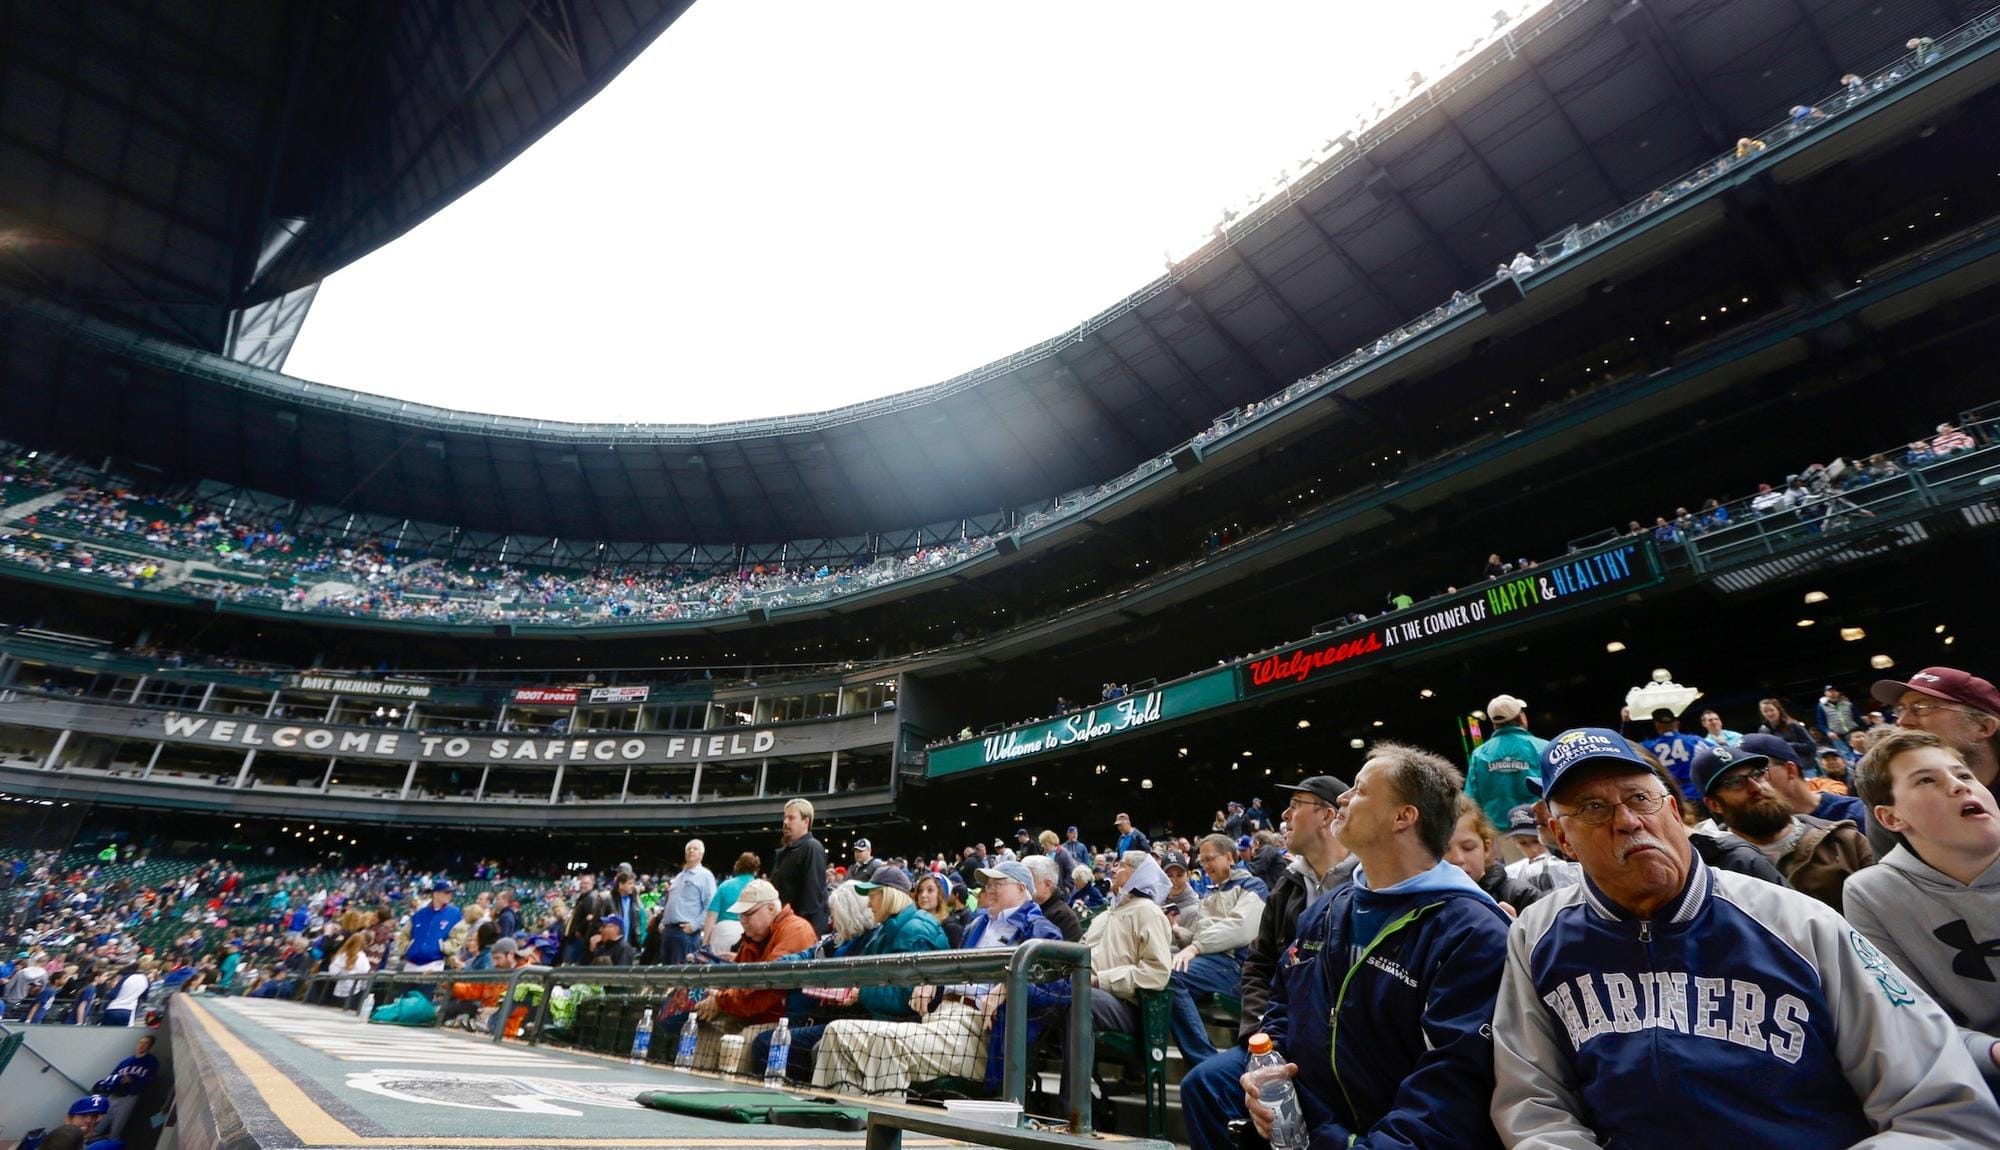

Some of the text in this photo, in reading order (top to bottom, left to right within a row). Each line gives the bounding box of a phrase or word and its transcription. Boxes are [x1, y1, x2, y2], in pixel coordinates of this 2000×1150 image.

[1250, 548, 1631, 686] Walgreens AT THE CORNER OF HAPPY & HEALTHY
[301, 677, 332, 690] DAVE
[332, 680, 382, 694] NIEHAUS
[515, 691, 576, 701] ROOT SPORTS
[163, 716, 775, 760] WELCOME TO SAFECO FIELD
[984, 691, 1162, 763] Welcome to Safeco Field
[1549, 735, 1612, 765] Corona
[1654, 738, 1690, 767] 24
[1543, 971, 1810, 1064] MARINERS
